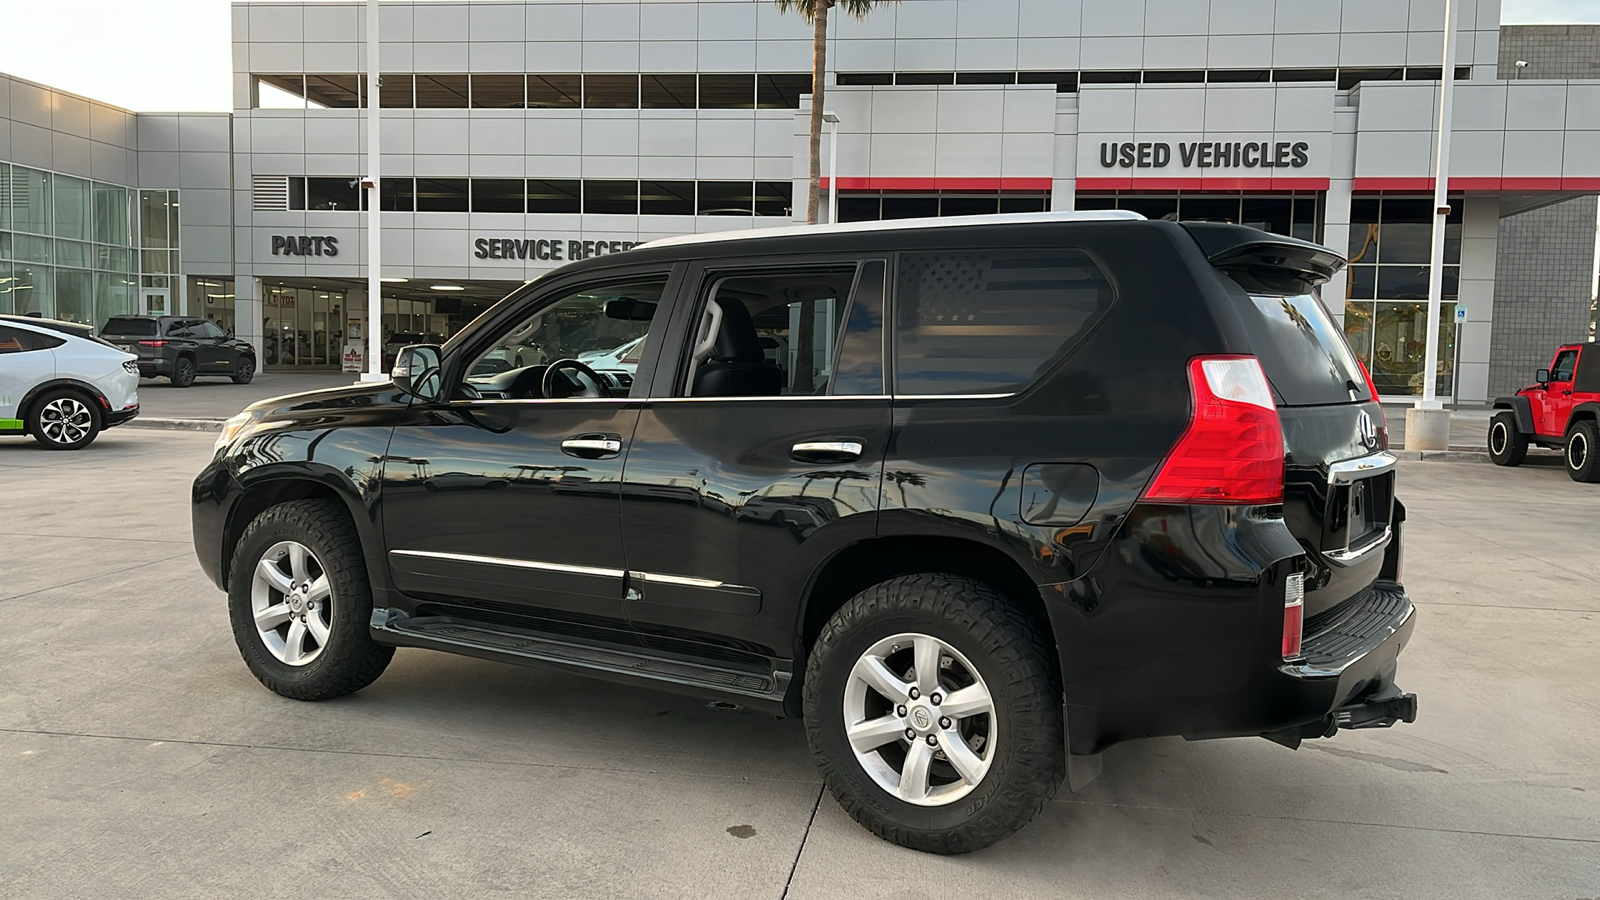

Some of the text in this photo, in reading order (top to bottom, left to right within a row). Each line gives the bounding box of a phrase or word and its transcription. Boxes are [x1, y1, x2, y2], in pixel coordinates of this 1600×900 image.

[1100, 142, 1309, 168] USED VEHICLES
[272, 235, 339, 256] PARTS
[474, 238, 648, 260] SERVICE RECEP
